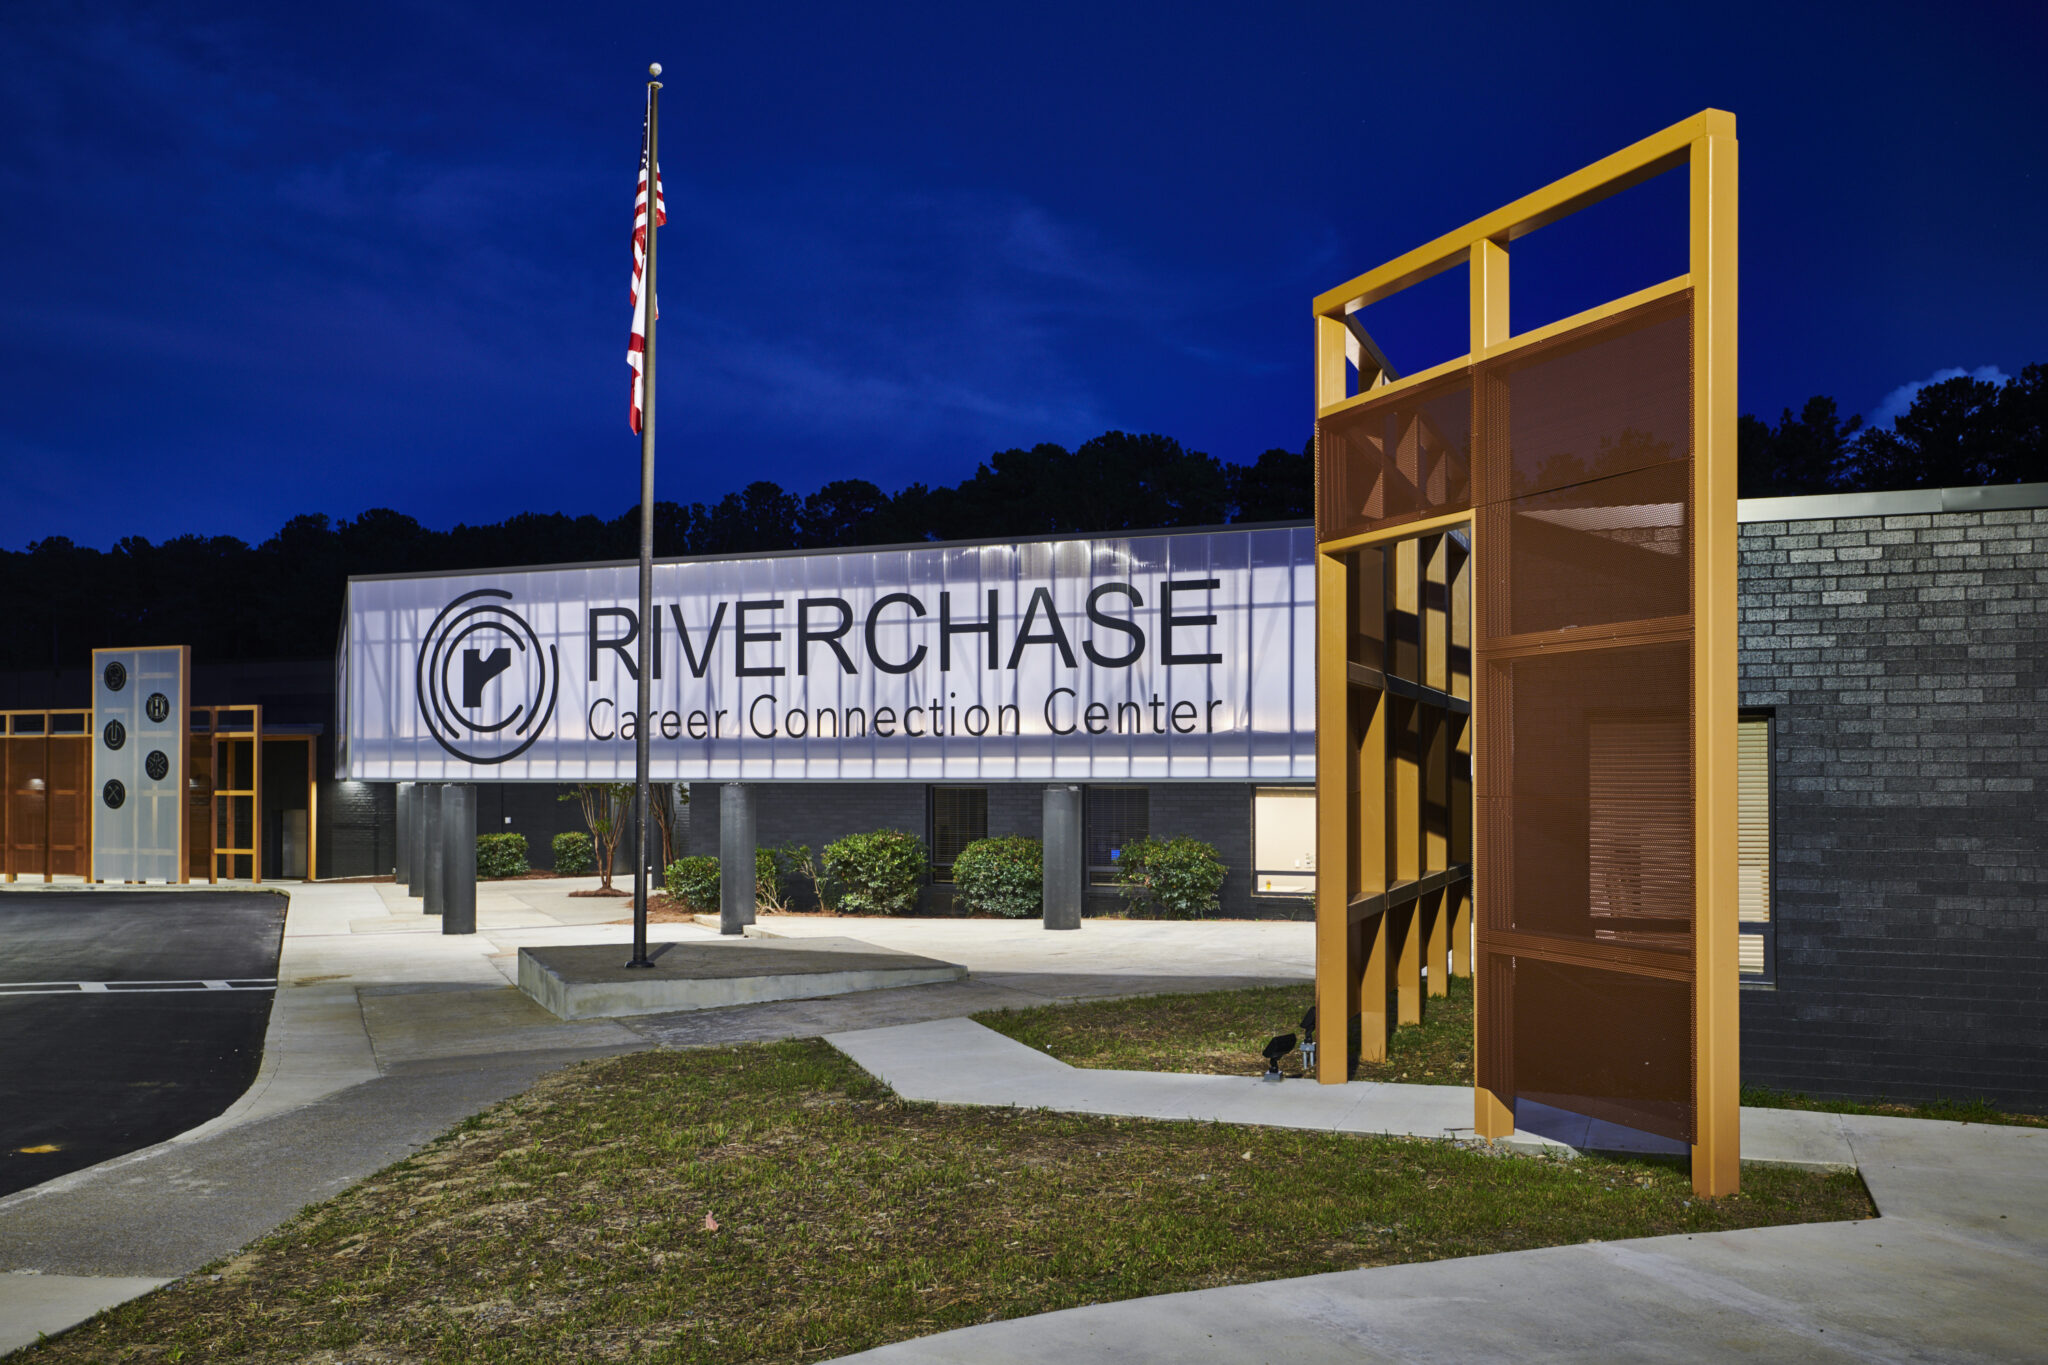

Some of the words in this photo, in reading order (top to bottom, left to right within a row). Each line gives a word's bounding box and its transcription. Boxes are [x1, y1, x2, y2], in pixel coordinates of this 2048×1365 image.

[589, 579, 1223, 681] RIVERCHASE
[749, 692, 1021, 740] Connection
[1044, 687, 1223, 735] Center
